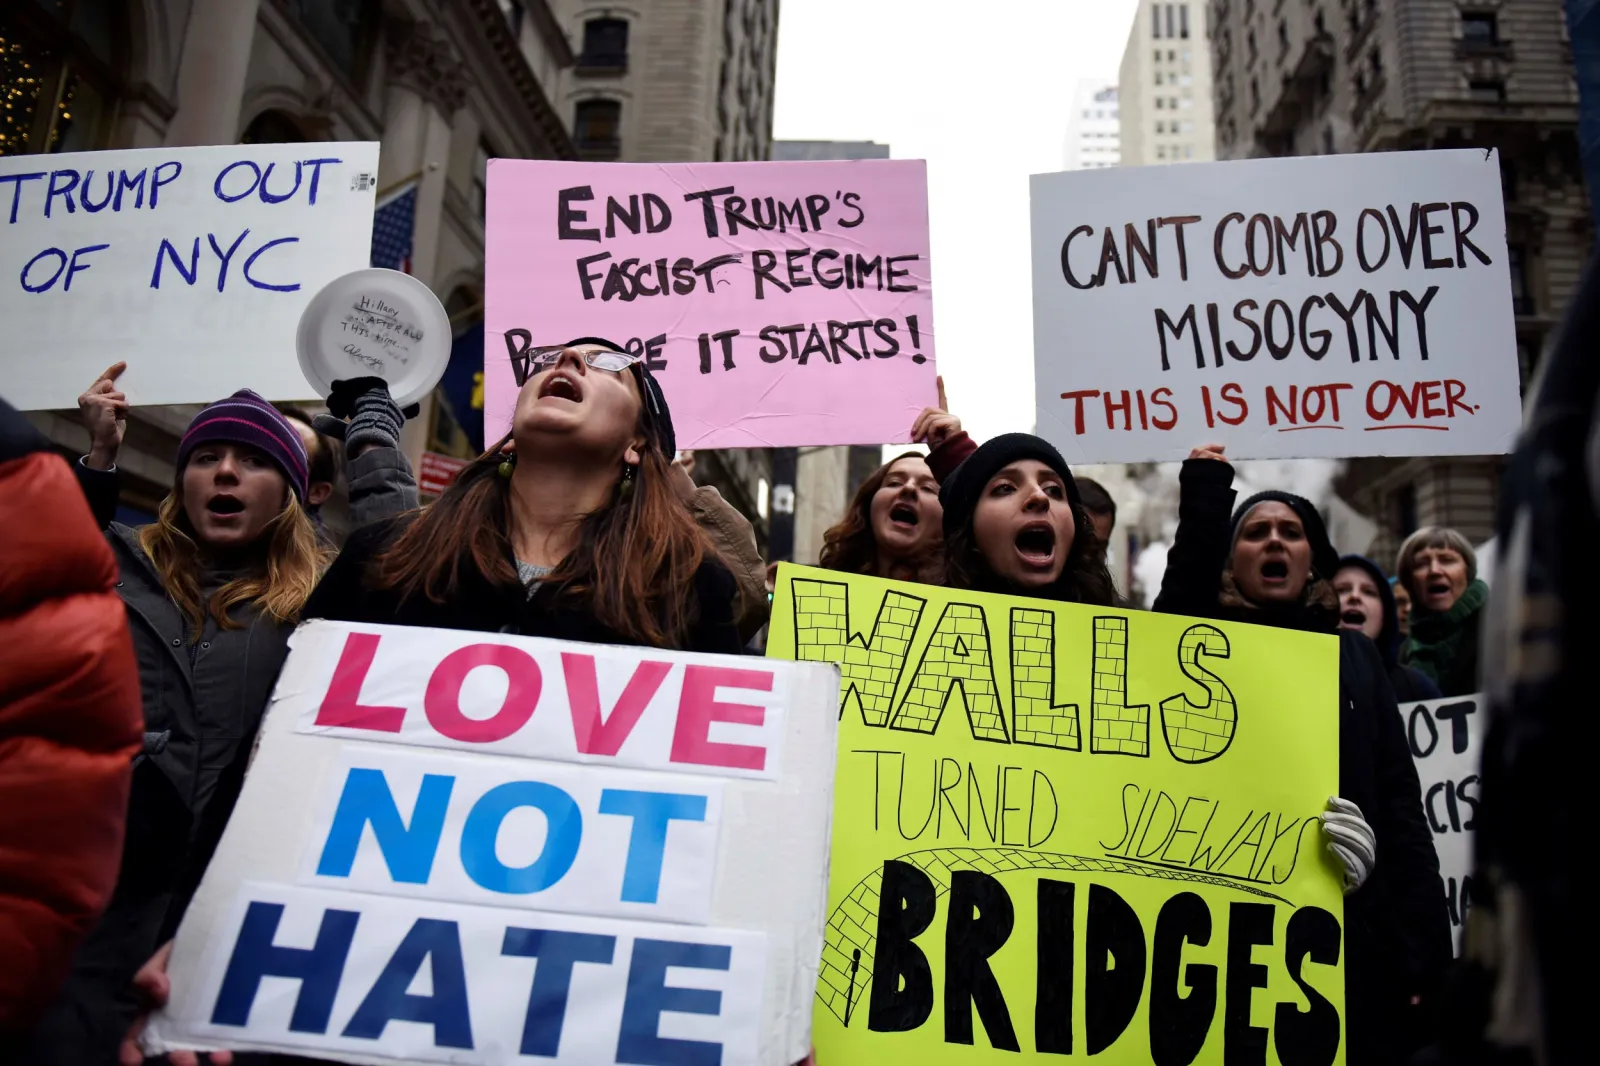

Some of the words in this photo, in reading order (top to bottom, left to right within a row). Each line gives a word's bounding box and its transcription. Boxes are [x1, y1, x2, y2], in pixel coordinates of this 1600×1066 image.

[0, 161, 182, 224] TRUMP
[214, 158, 342, 206] OUT
[558, 185, 672, 243] END
[684, 186, 864, 238] TRUMP'S
[20, 244, 110, 293] OF
[150, 228, 301, 292] NYC
[576, 251, 743, 302] FASCIST
[752, 247, 920, 300] REGIME
[1214, 210, 1344, 280] COMB
[1356, 201, 1493, 274] OVER
[698, 329, 740, 374] IT
[759, 315, 928, 365] STARTS!
[1154, 286, 1440, 371] MISOGYNY
[1061, 387, 1178, 435] THIS
[1201, 383, 1249, 428] IS
[1266, 383, 1353, 426] NOT
[1366, 380, 1480, 422] OVER.
[313, 632, 775, 770] LOVE
[791, 577, 1238, 764] WALLS
[316, 767, 709, 904] NOT
[851, 750, 1059, 849] TURNED
[1099, 783, 1321, 885] SIDEWAYS
[211, 900, 733, 1066] HATE
[867, 859, 1342, 1066] BRIDGES
